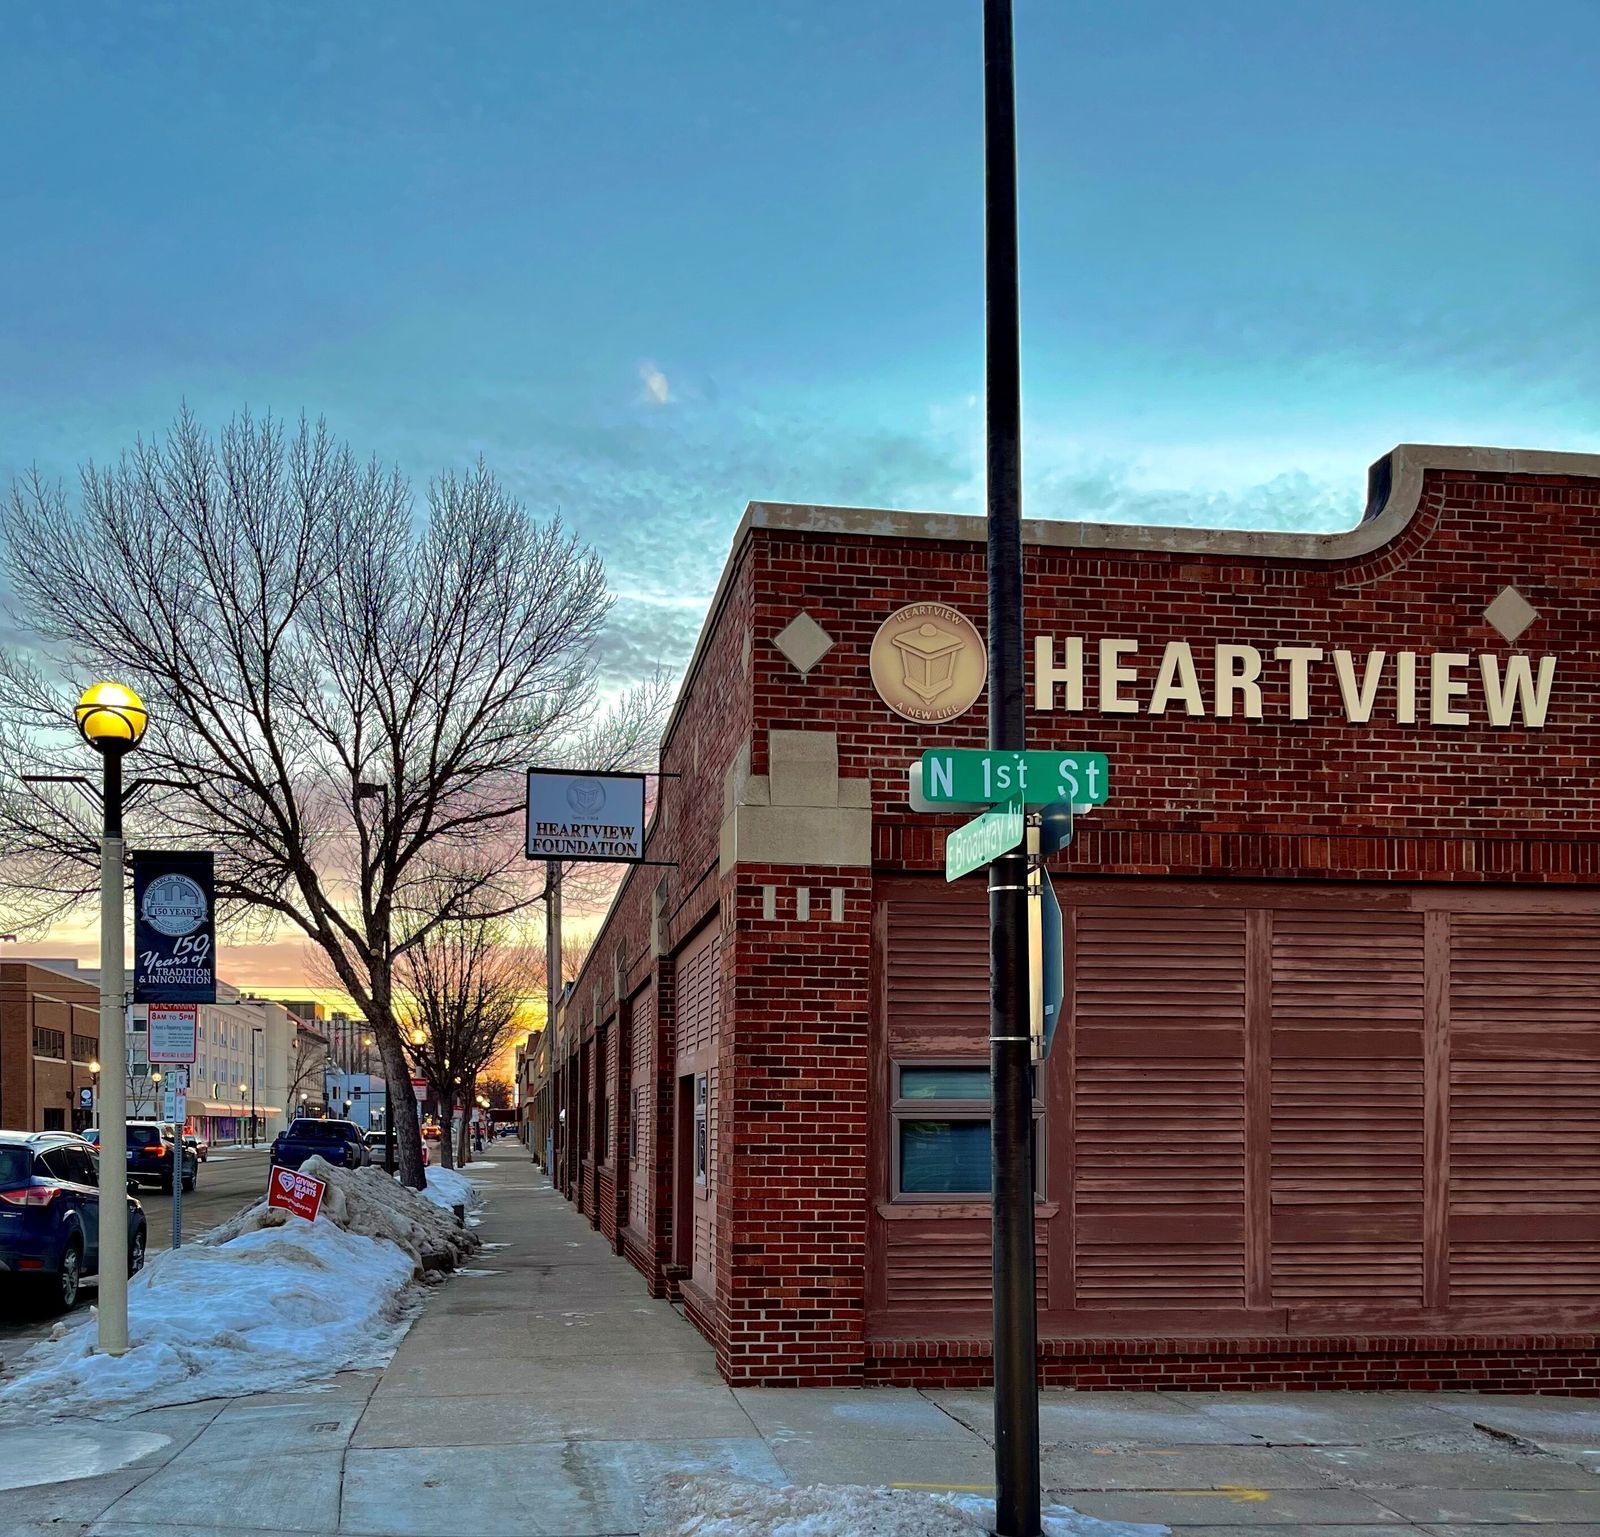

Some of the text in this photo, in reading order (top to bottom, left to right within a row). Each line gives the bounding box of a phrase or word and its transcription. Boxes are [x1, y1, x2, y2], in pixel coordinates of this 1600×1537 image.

[896, 605, 963, 625] HEARTVIEW
[1034, 635, 1558, 728] HEARTVIEW
[896, 702, 960, 720] A NEW LIFE
[930, 757, 1100, 800] N 1st St
[535, 821, 635, 840] HEARTVIEW
[532, 838, 638, 856] FOUNDATION
[956, 815, 1004, 870] Broadway
[169, 908, 197, 916] YEARS
[173, 934, 209, 955] 150
[140, 944, 210, 974] Years of
[139, 975, 211, 984] & INNOVATION
[155, 967, 211, 976] TRADITION
[151, 1012, 167, 1020] 8AM
[179, 1012, 194, 1021] 5PM
[295, 1176, 317, 1190] GIVING
